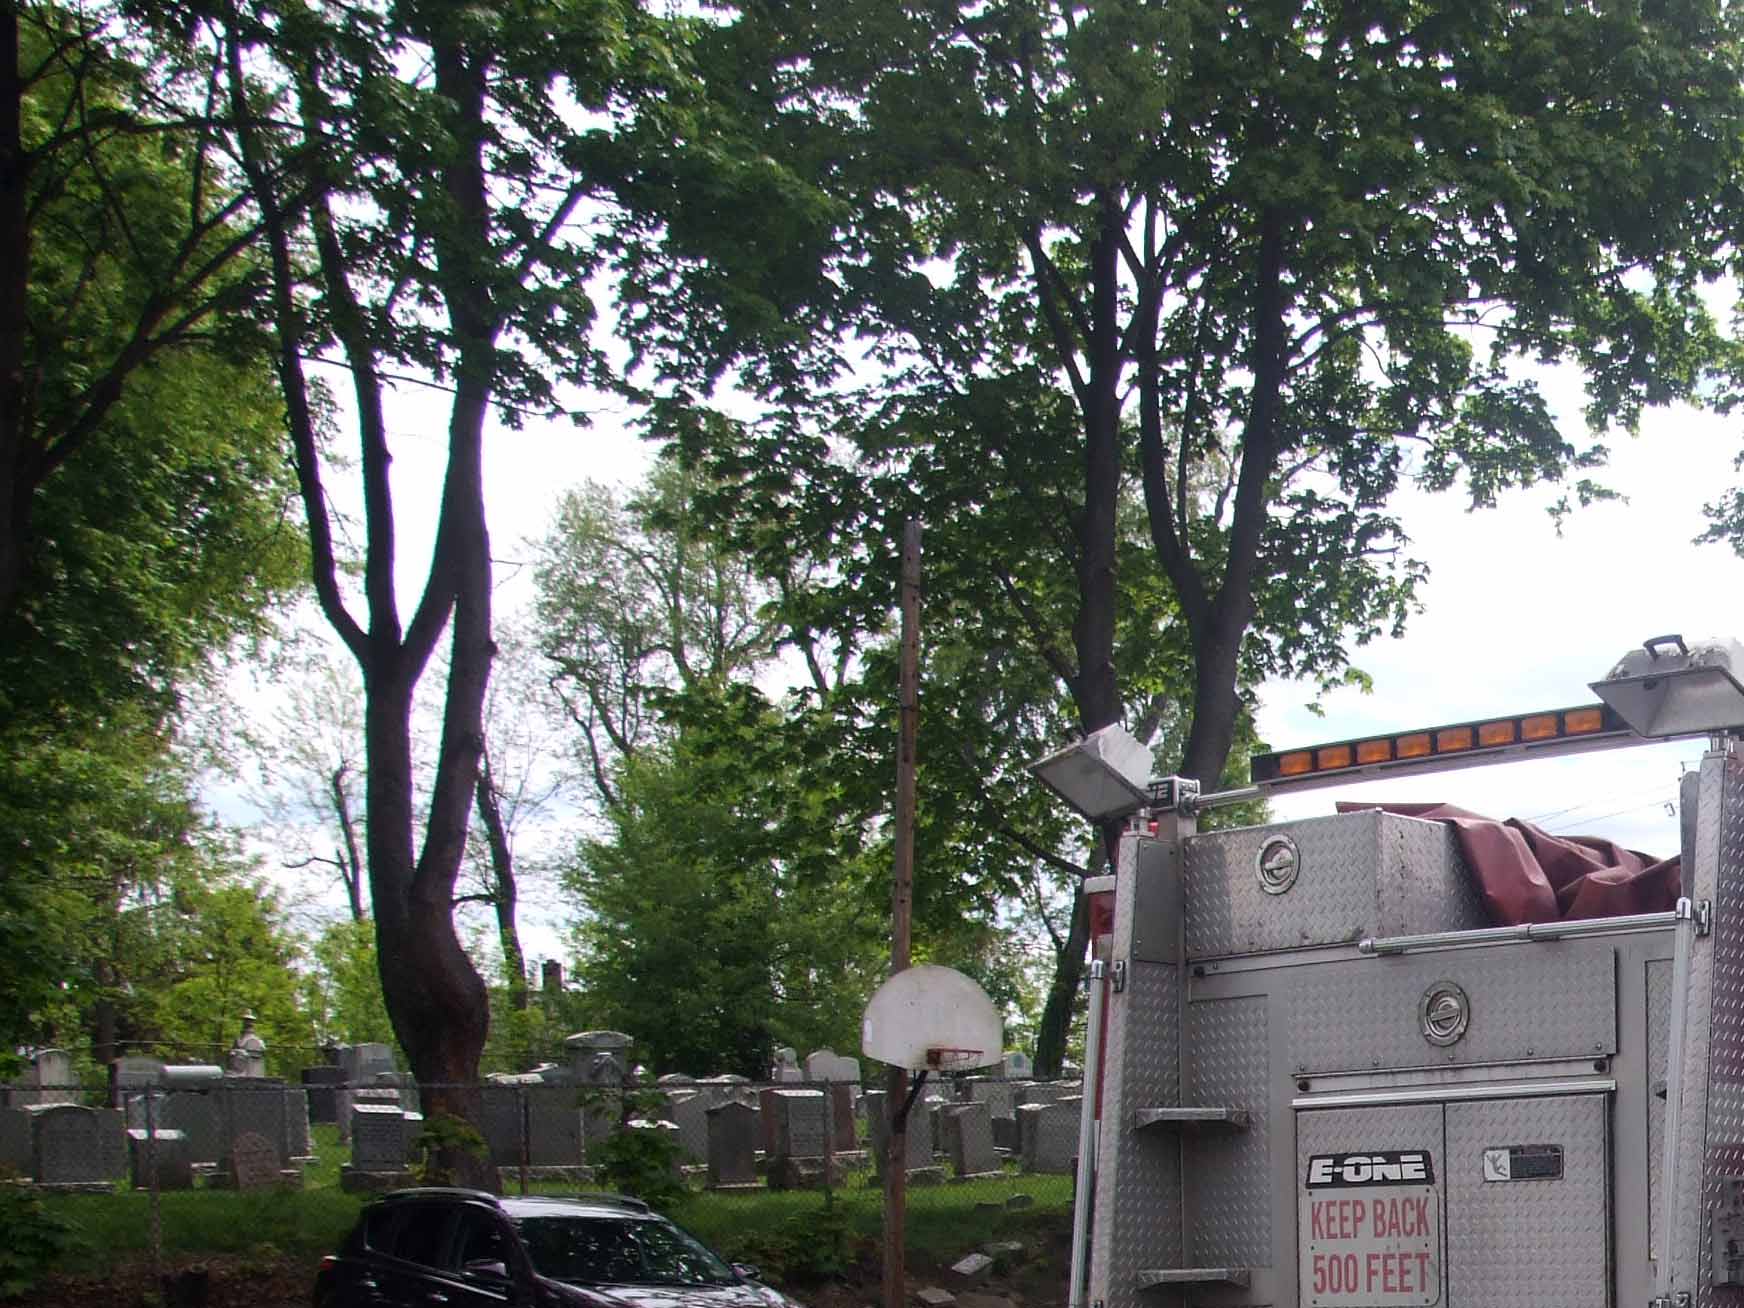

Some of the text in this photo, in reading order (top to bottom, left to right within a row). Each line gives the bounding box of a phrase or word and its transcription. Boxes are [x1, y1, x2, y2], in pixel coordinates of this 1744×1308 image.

[1310, 1155, 1426, 1183] E-ONE
[1312, 1197, 1429, 1240] KEEP BACK
[1313, 1252, 1430, 1294] 500 FEET
